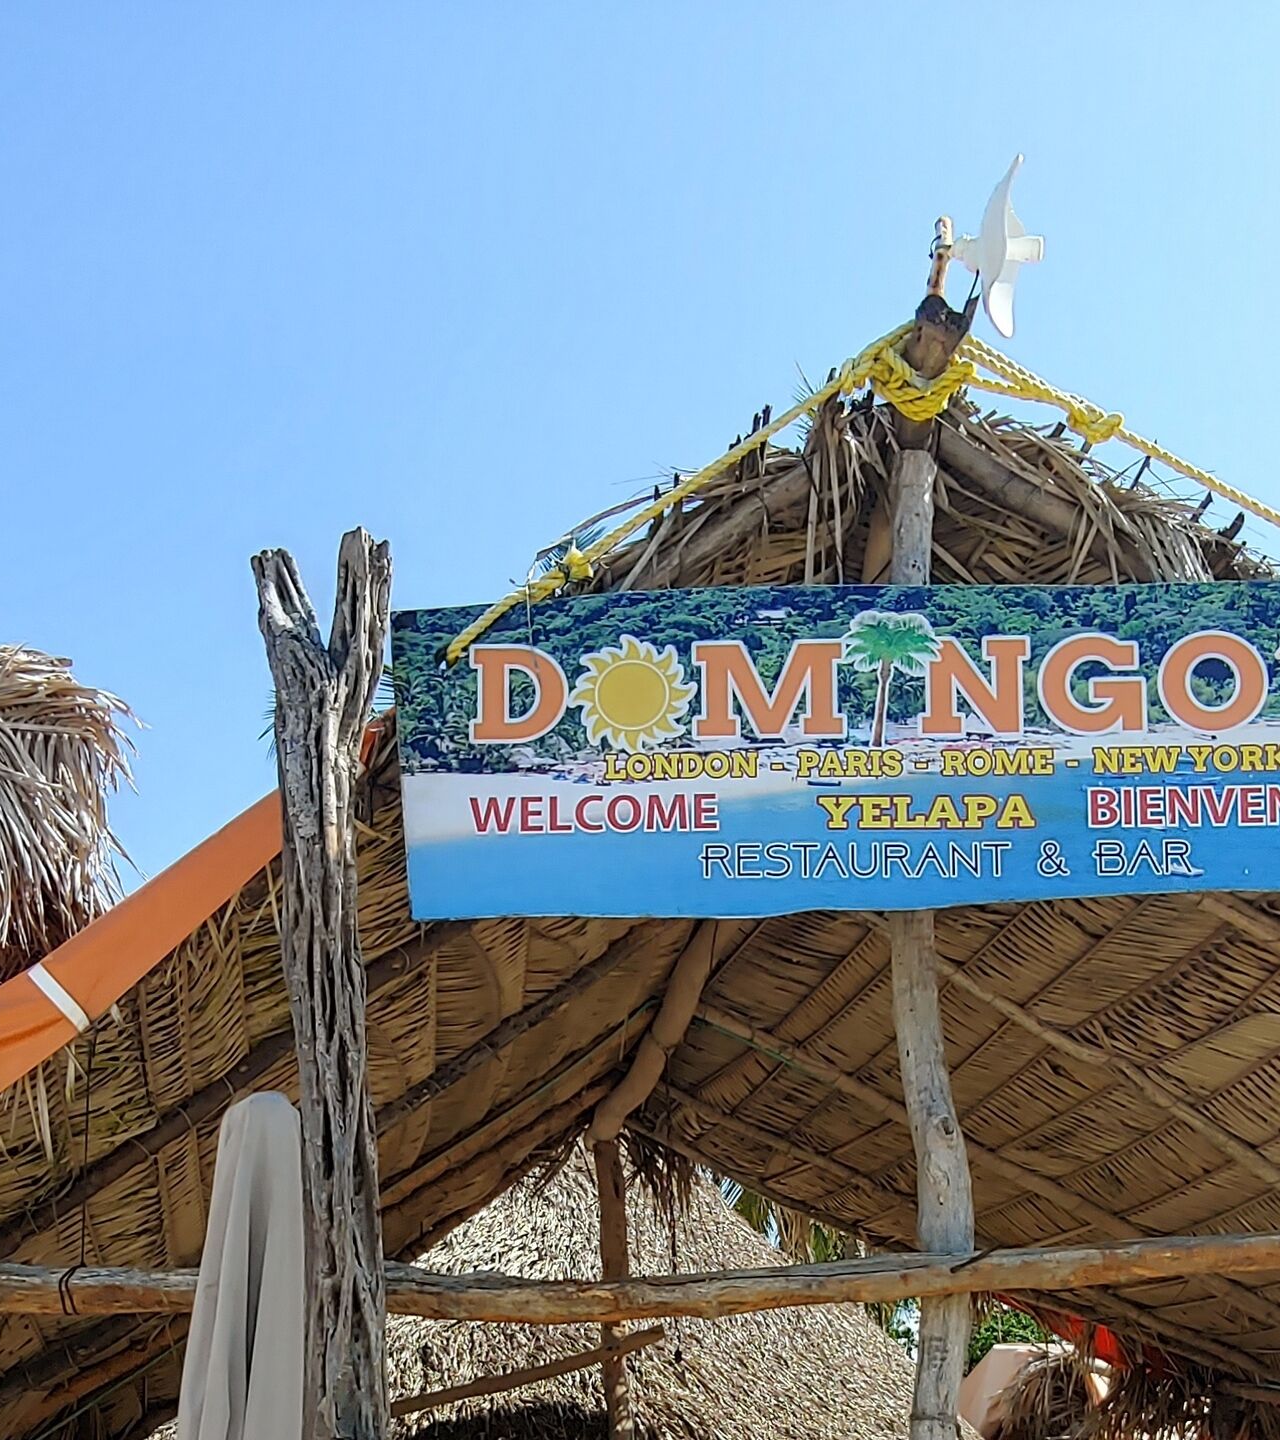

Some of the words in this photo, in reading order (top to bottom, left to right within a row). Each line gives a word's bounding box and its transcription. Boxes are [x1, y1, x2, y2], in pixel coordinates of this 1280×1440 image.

[604, 748, 760, 780] LONDON
[797, 748, 904, 778] PARIS
[941, 746, 1055, 778] ROME
[1093, 745, 1183, 774] NEW
[469, 793, 720, 834] WELCOME
[818, 794, 1037, 830] YELAPA
[698, 840, 1012, 879] RESTAURANT
[1037, 840, 1071, 877] &
[1093, 838, 1192, 876] BAR
